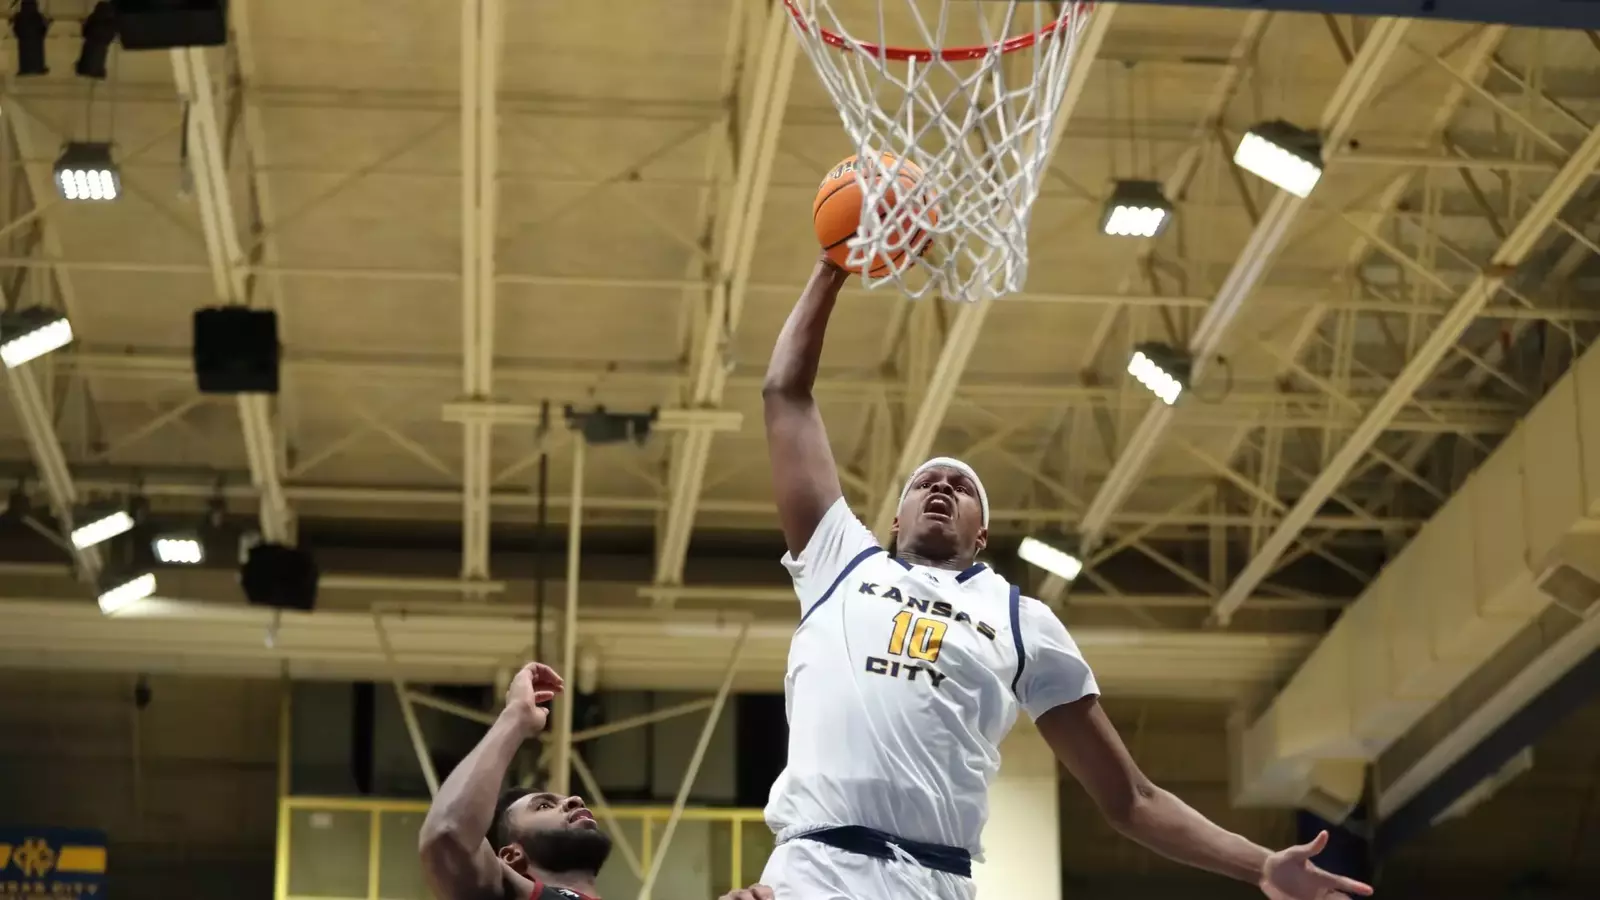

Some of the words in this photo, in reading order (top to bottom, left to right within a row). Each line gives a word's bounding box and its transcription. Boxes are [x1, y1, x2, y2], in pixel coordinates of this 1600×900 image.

[858, 581, 996, 641] KANSAS
[887, 610, 948, 663] 10
[865, 656, 947, 688] CITY
